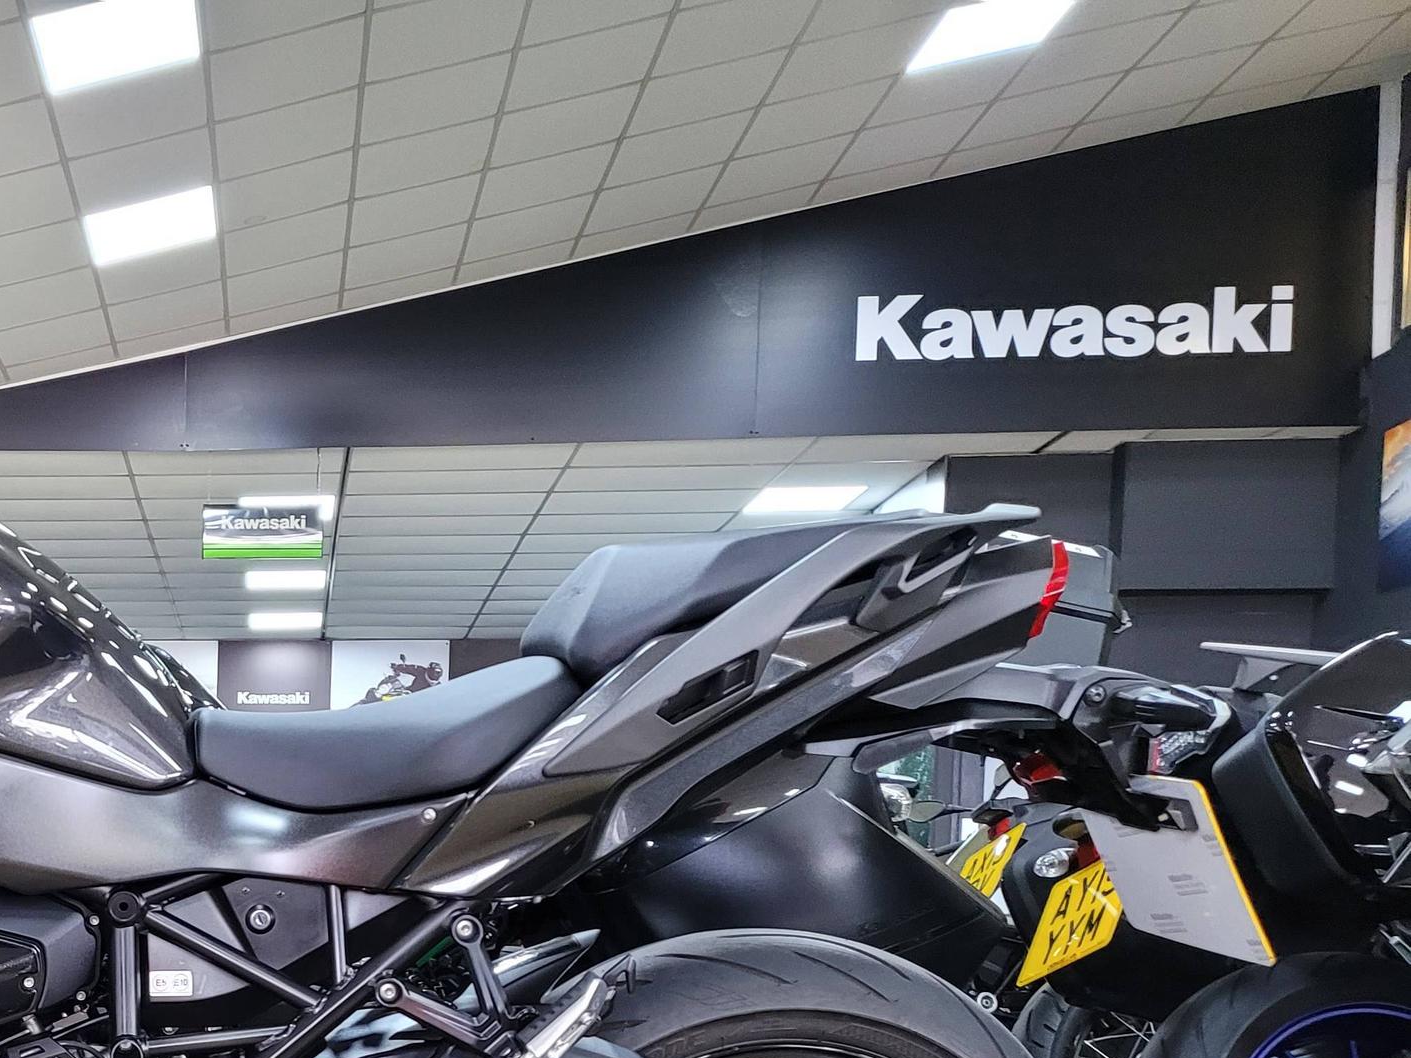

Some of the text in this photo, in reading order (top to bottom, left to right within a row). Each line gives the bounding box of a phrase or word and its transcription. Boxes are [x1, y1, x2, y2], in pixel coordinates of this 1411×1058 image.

[854, 284, 1295, 362] Kawasaki
[221, 513, 307, 530] Kawasaki
[236, 691, 310, 705] Kawasaki
